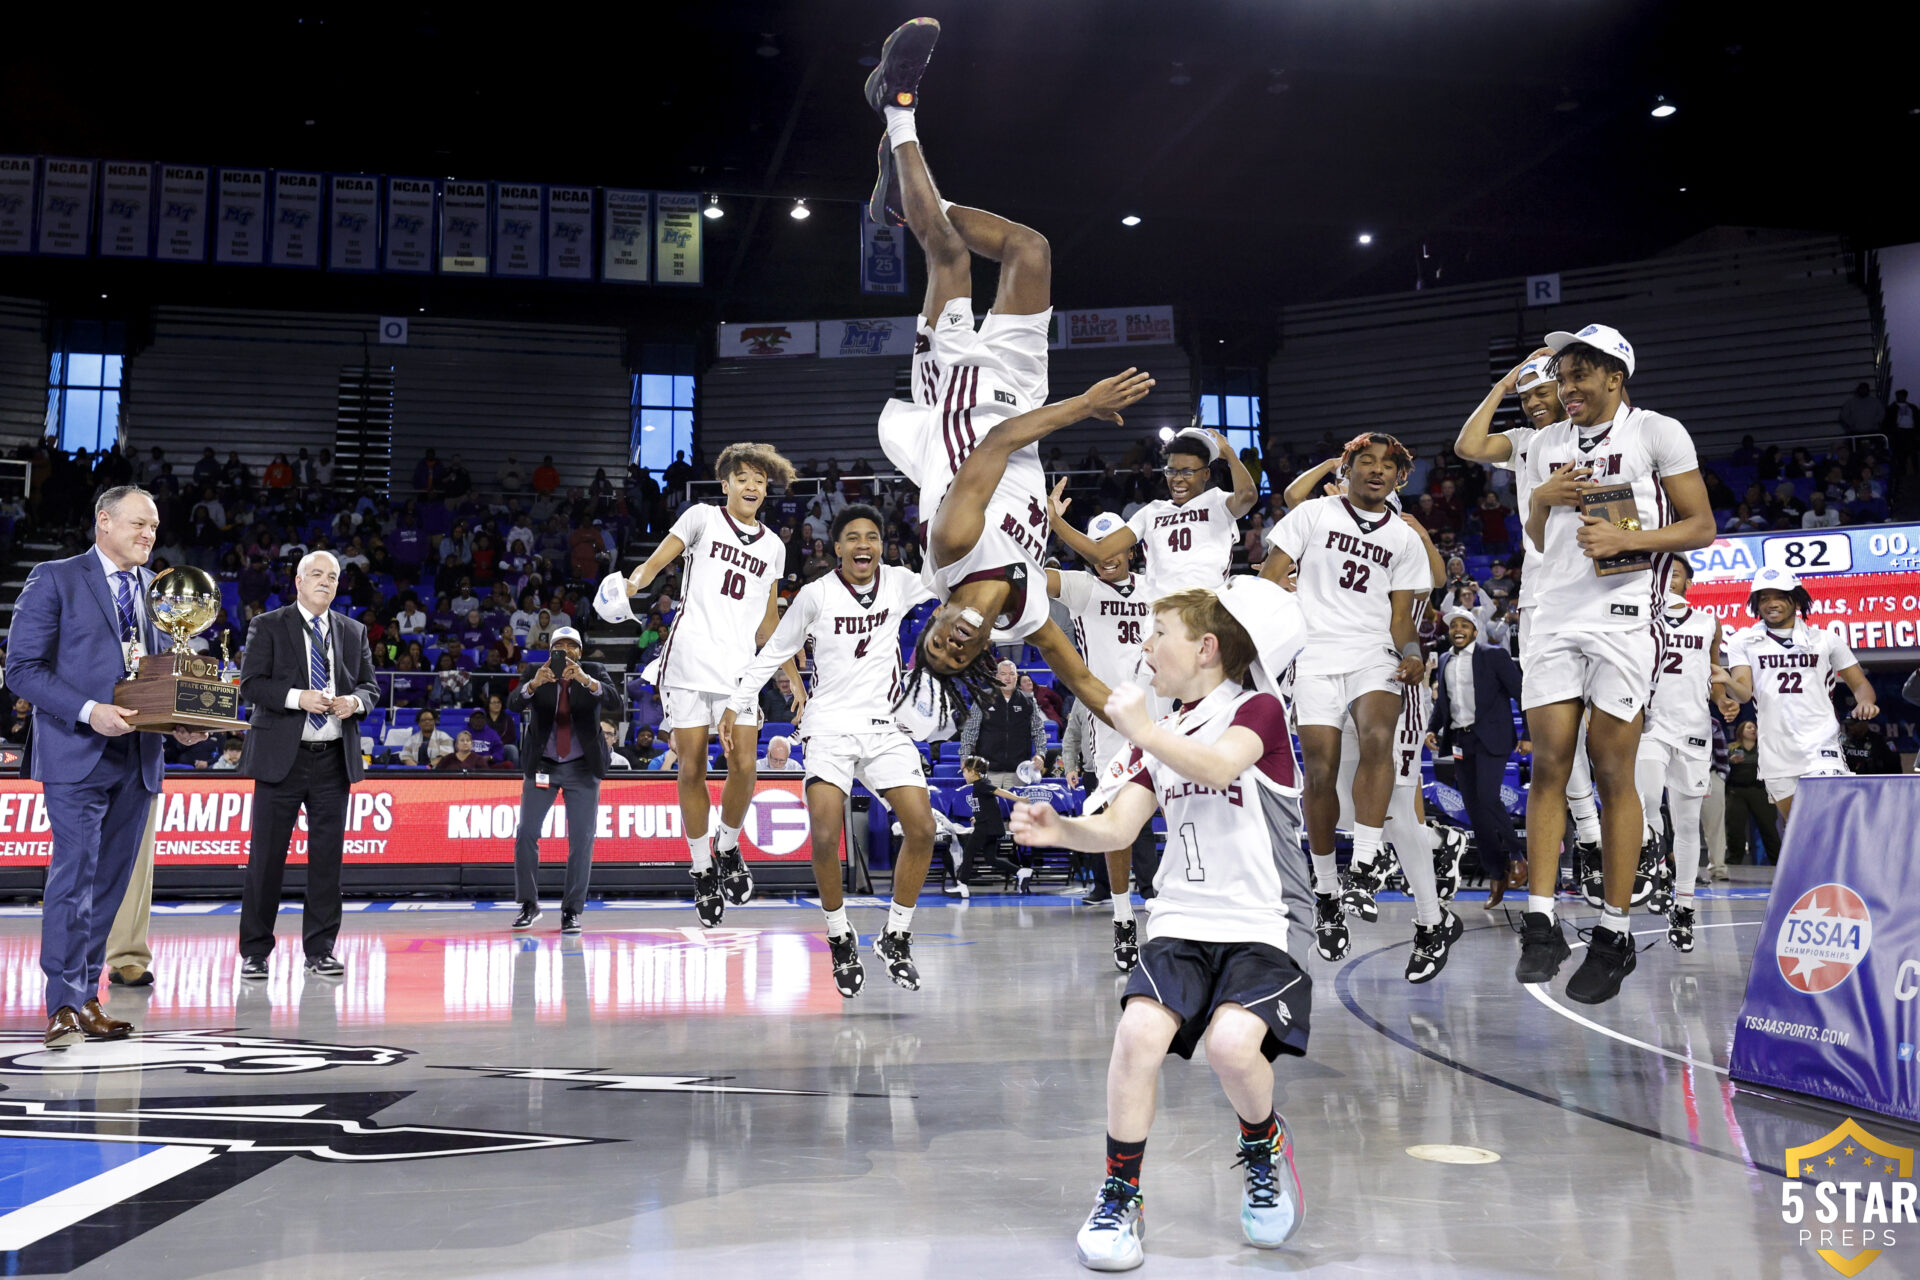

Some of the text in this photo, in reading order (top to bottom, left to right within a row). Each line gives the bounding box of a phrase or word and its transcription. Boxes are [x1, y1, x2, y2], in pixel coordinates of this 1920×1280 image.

[0, 160, 30, 171] CAA
[49, 162, 88, 174] NCAA
[108, 165, 148, 177] NCAA
[166, 168, 204, 180] NCAA
[223, 172, 262, 184] NCAA
[280, 176, 317, 187] NCAA
[336, 180, 374, 191] NCAA
[393, 181, 431, 193] NCAA
[447, 184, 485, 197] NCAA
[501, 187, 538, 199] NCAA
[552, 190, 589, 202] NCAA
[875, 258, 894, 271] 25
[1534, 280, 1552, 299] R
[385, 323, 402, 338] O
[1154, 508, 1209, 530] FULTON
[1168, 527, 1192, 552] 40
[1326, 530, 1394, 568] FULTON
[1784, 540, 1831, 568] 82
[709, 541, 768, 578] FULTON
[1689, 547, 1751, 572] SAA
[720, 569, 747, 600] 10
[1339, 560, 1371, 594] 32
[1100, 600, 1150, 617] FULTO
[1858, 595, 1897, 612] IT'S
[834, 608, 889, 634] FULTON
[1117, 621, 1143, 644] 30
[1827, 620, 1920, 649] OFFIC
[1665, 633, 1704, 650] LTON
[1758, 653, 1820, 670] FULTON
[1777, 672, 1803, 694] 22
[618, 805, 725, 838] FULTN
[1179, 822, 1205, 882] 1
[1787, 919, 1861, 950] TSSAA
[1784, 946, 1850, 960] CHAMPIONSHIPS
[1744, 1015, 1849, 1047] TSSAASPORTS.COM
